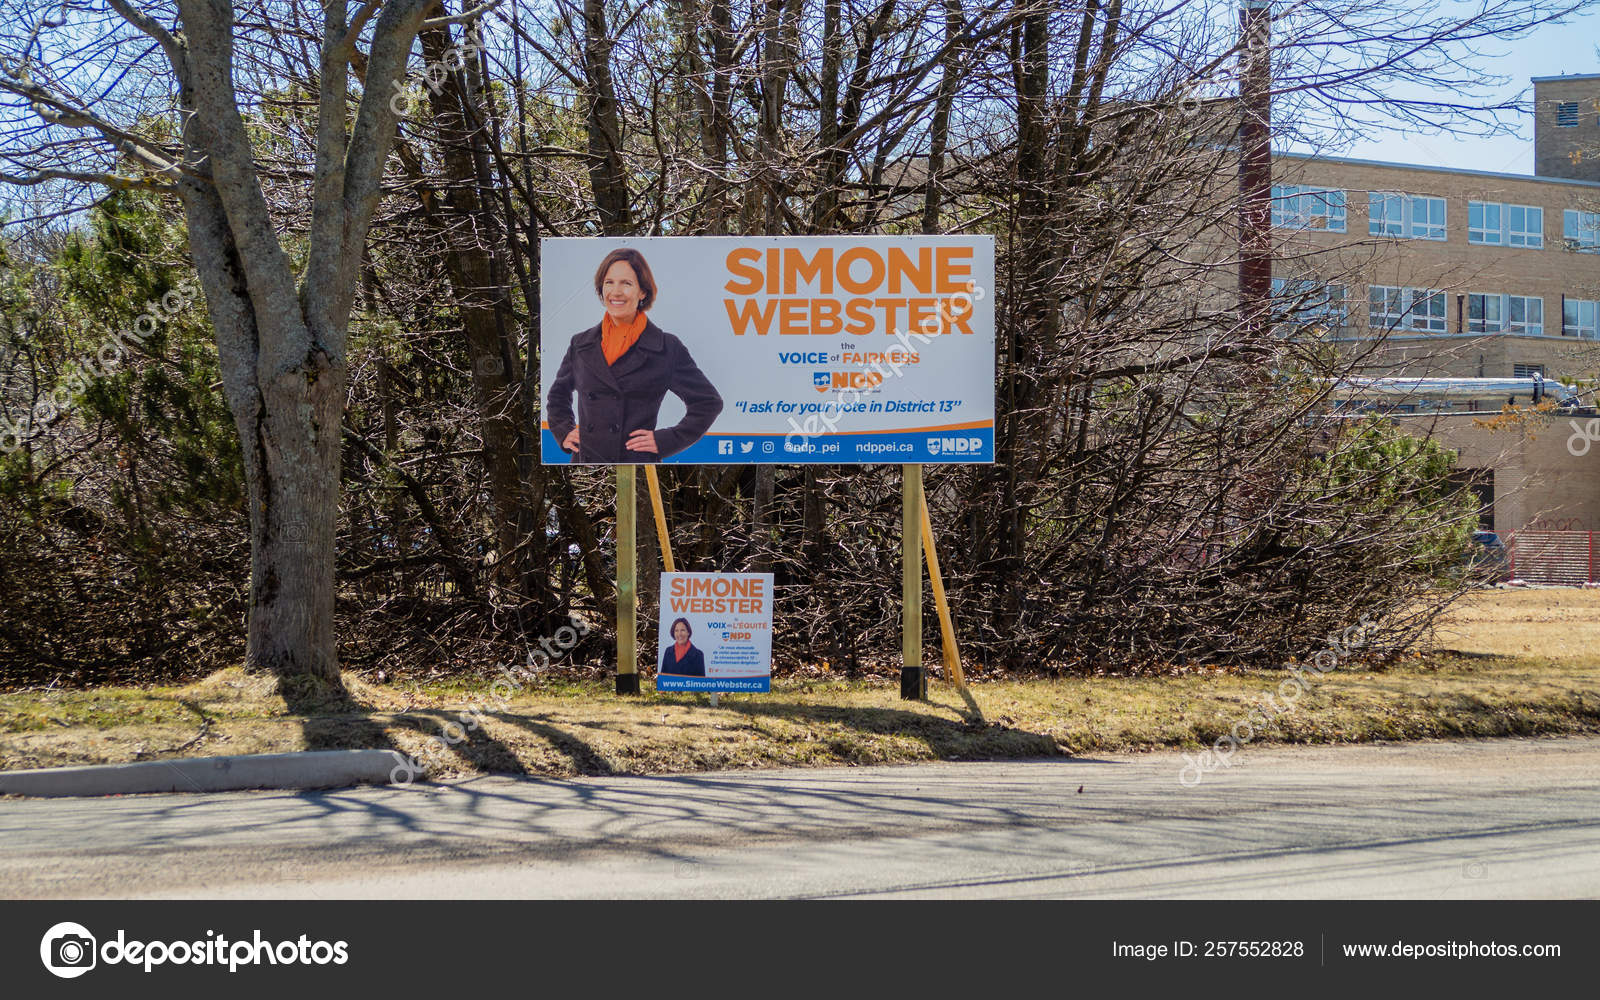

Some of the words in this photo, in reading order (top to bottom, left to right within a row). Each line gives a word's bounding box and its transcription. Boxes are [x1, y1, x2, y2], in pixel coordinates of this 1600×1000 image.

[723, 246, 974, 295] SIMONE
[723, 298, 974, 336] WEBSTER
[840, 342, 856, 350] the
[778, 352, 828, 364] VOICE
[830, 354, 840, 363] of
[843, 352, 920, 364] FAIRNESS
[832, 371, 883, 389] NDP
[749, 401, 774, 413] ask
[776, 401, 797, 413] for
[799, 403, 830, 416] your
[835, 403, 867, 413] vote
[869, 401, 882, 413] in
[884, 401, 937, 413] District
[855, 441, 914, 454] ndppei.ca
[941, 438, 983, 451] NDP
[670, 577, 764, 598] SIMONE
[670, 598, 763, 614] WEBSTER
[707, 622, 727, 630] VOIX
[730, 632, 752, 640] NPD
[662, 680, 763, 690] www.SimoneWebster.ca
